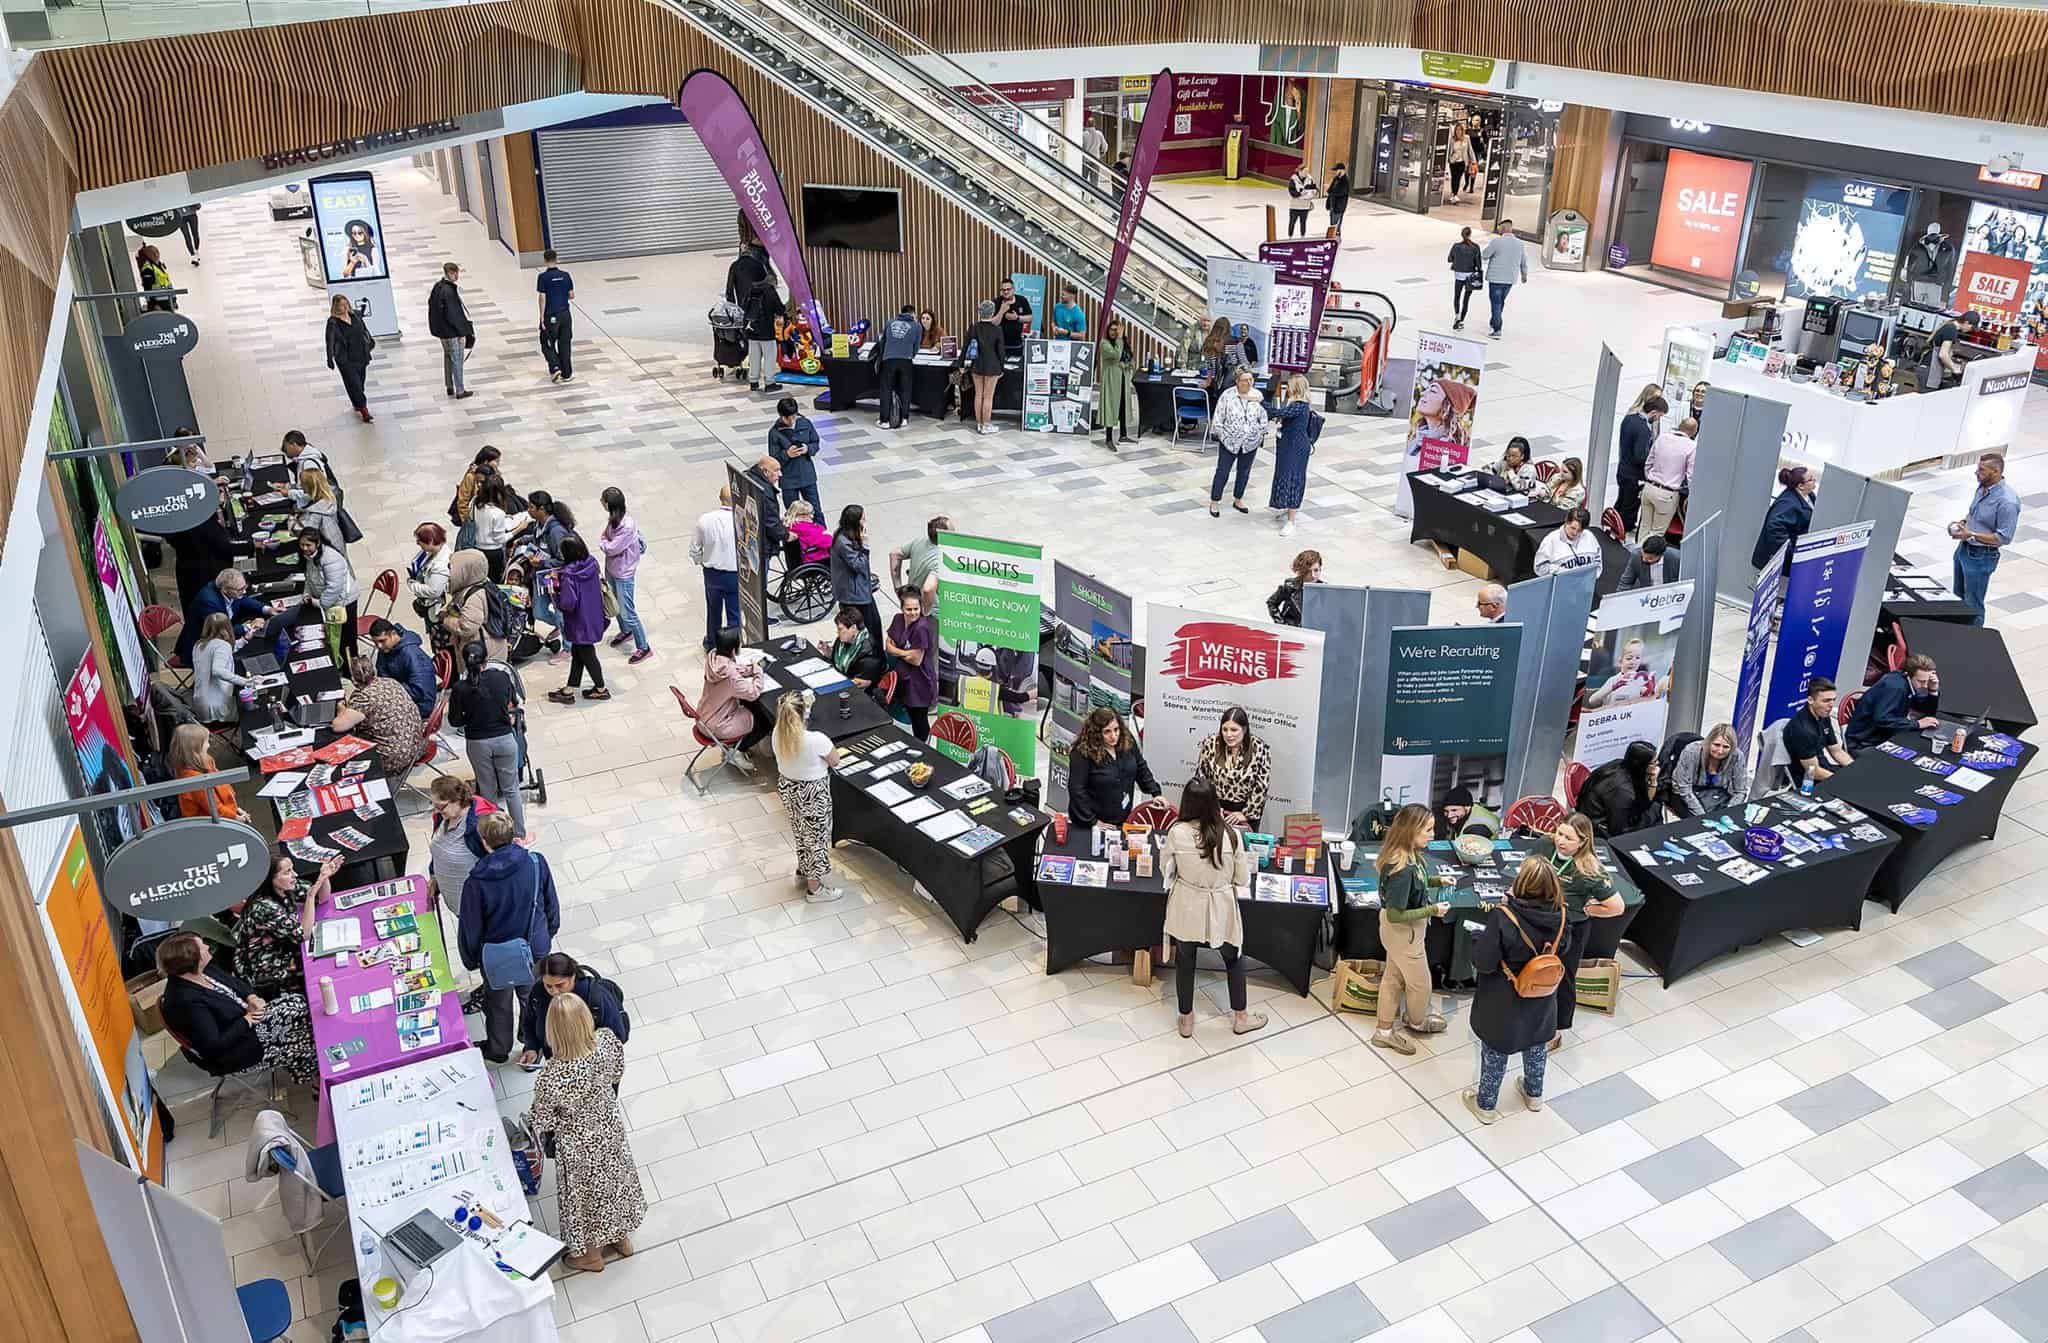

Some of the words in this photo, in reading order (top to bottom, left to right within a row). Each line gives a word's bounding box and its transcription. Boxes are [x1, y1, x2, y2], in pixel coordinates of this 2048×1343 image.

[1176, 89, 1190, 101] Gift
[1191, 88, 1210, 98] Card
[1176, 102, 1208, 113] Available
[1208, 101, 1224, 111] here
[1843, 183, 1877, 199] GAME
[322, 194, 368, 210] EASY
[1677, 187, 1739, 217] SALE
[1975, 276, 2011, 296] SALE
[142, 338, 177, 347] LEXICON
[1428, 345, 1446, 354] HERO
[1429, 340, 1453, 350] HEALTH
[1984, 376, 2028, 394] NuoNuo
[165, 494, 186, 505] THE
[142, 502, 189, 516] LEXICON
[957, 555, 1020, 580] SHORTS
[943, 590, 1001, 609] RECRUITING
[1002, 599, 1031, 614] NOW
[1077, 582, 1106, 606] SHORTS
[1650, 591, 1687, 609] debra
[943, 617, 1032, 641] shorts-group.co.uk
[1399, 646, 1437, 658] We're
[1440, 644, 1501, 660] Recruiting
[1199, 655, 1269, 679] HIRING
[1251, 713, 1273, 725] Head
[1273, 717, 1298, 730] Office
[1587, 713, 1618, 728] DEBRA
[1620, 710, 1633, 722] UK
[978, 733, 996, 746] Tool
[1585, 730, 1597, 741] Our
[184, 863, 219, 879] THE
[148, 873, 222, 898] LEXICON
